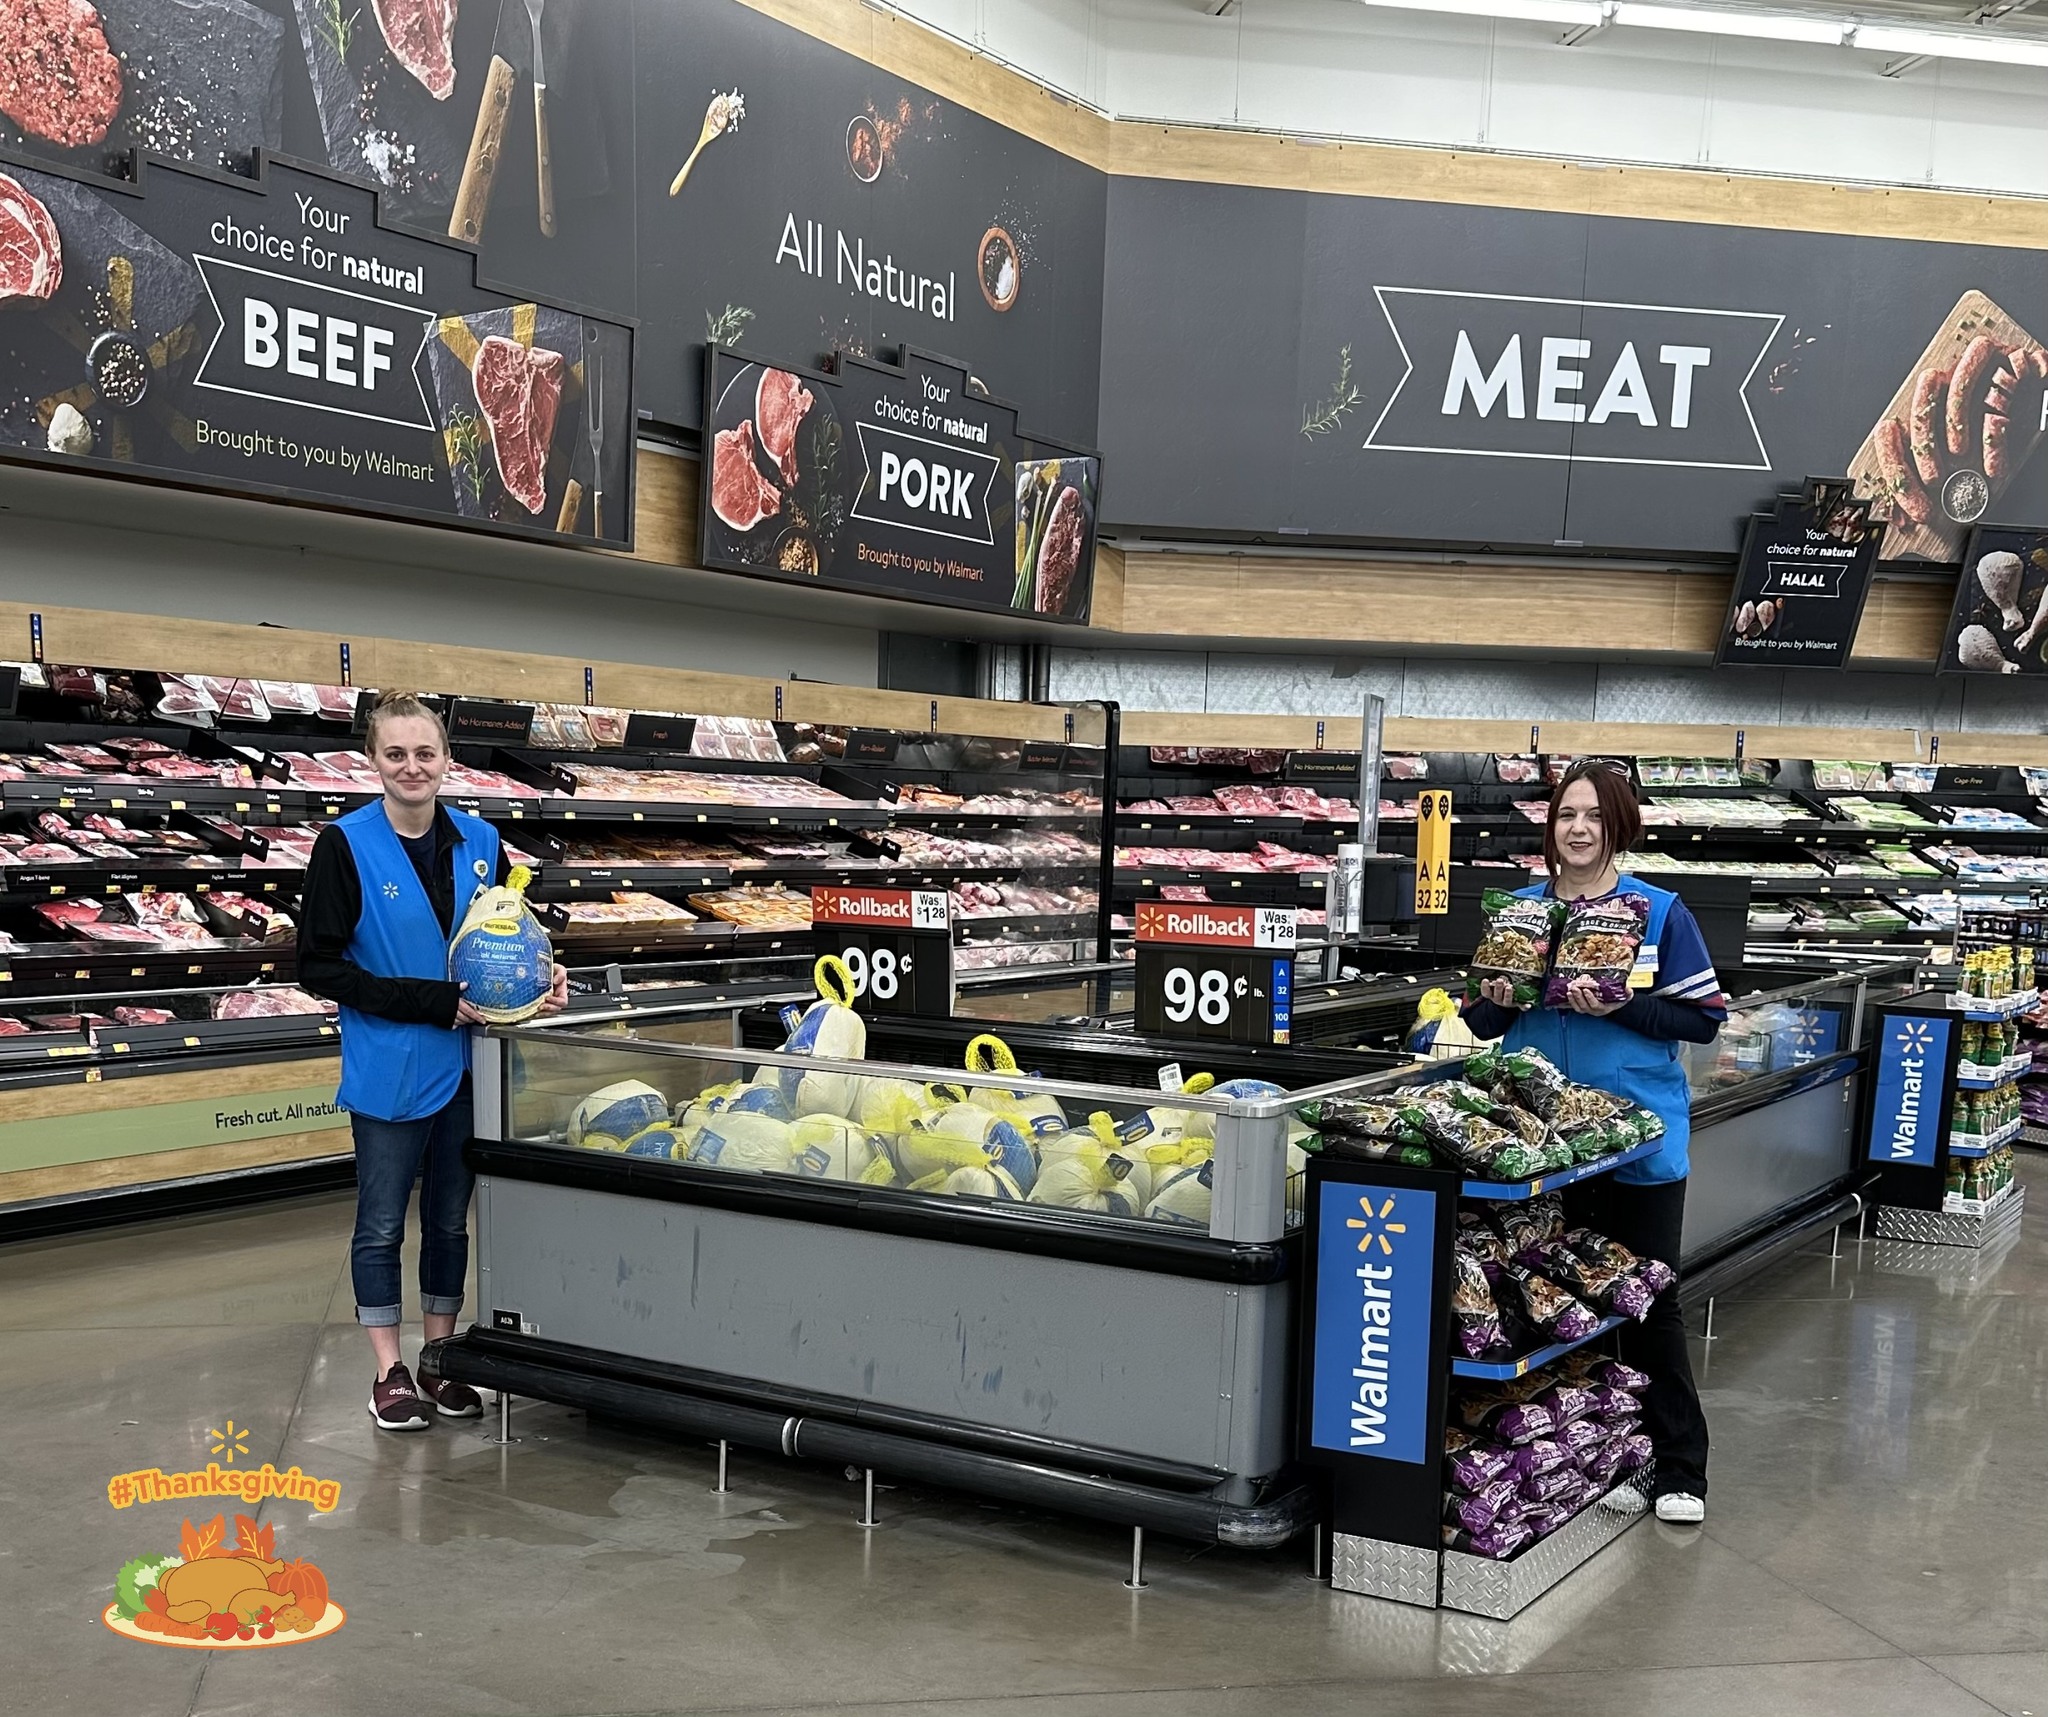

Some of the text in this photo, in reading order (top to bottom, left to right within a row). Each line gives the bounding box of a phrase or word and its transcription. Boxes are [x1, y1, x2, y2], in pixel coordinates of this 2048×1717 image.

[295, 191, 350, 235] Your
[210, 215, 425, 296] choice for natural
[775, 212, 955, 322] All Natural
[243, 296, 395, 391] BEEF
[920, 374, 951, 405] Your
[1441, 329, 1711, 429] MEAT
[874, 396, 988, 444] choice for natural
[195, 419, 435, 483] Brought to you by Walmart
[878, 451, 975, 520] PORK
[1805, 528, 1829, 541] Your
[1766, 543, 1858, 558] choice for natural
[857, 542, 984, 583] Brought to you by Walmart
[1779, 572, 1826, 588] HALAL
[1735, 638, 1837, 650] Brought to you by Walmart
[1419, 860, 1430, 882] A
[1436, 860, 1446, 882] A
[839, 896, 911, 919] Rollback
[919, 893, 943, 907] Was:
[1417, 889, 1431, 909] 32
[1434, 889, 1447, 909] 32
[1167, 913, 1251, 938] Rollback
[1264, 910, 1291, 925] Was:
[471, 936, 525, 953] Premium
[1278, 968, 1286, 977] A
[1253, 988, 1265, 998] lb.
[1277, 986, 1287, 995] 32
[1274, 1012, 1289, 1022] 100
[215, 1102, 348, 1129] Fresh cut. All natura
[1890, 1058, 1924, 1160] Walmart
[1350, 1262, 1393, 1448] Walmart
